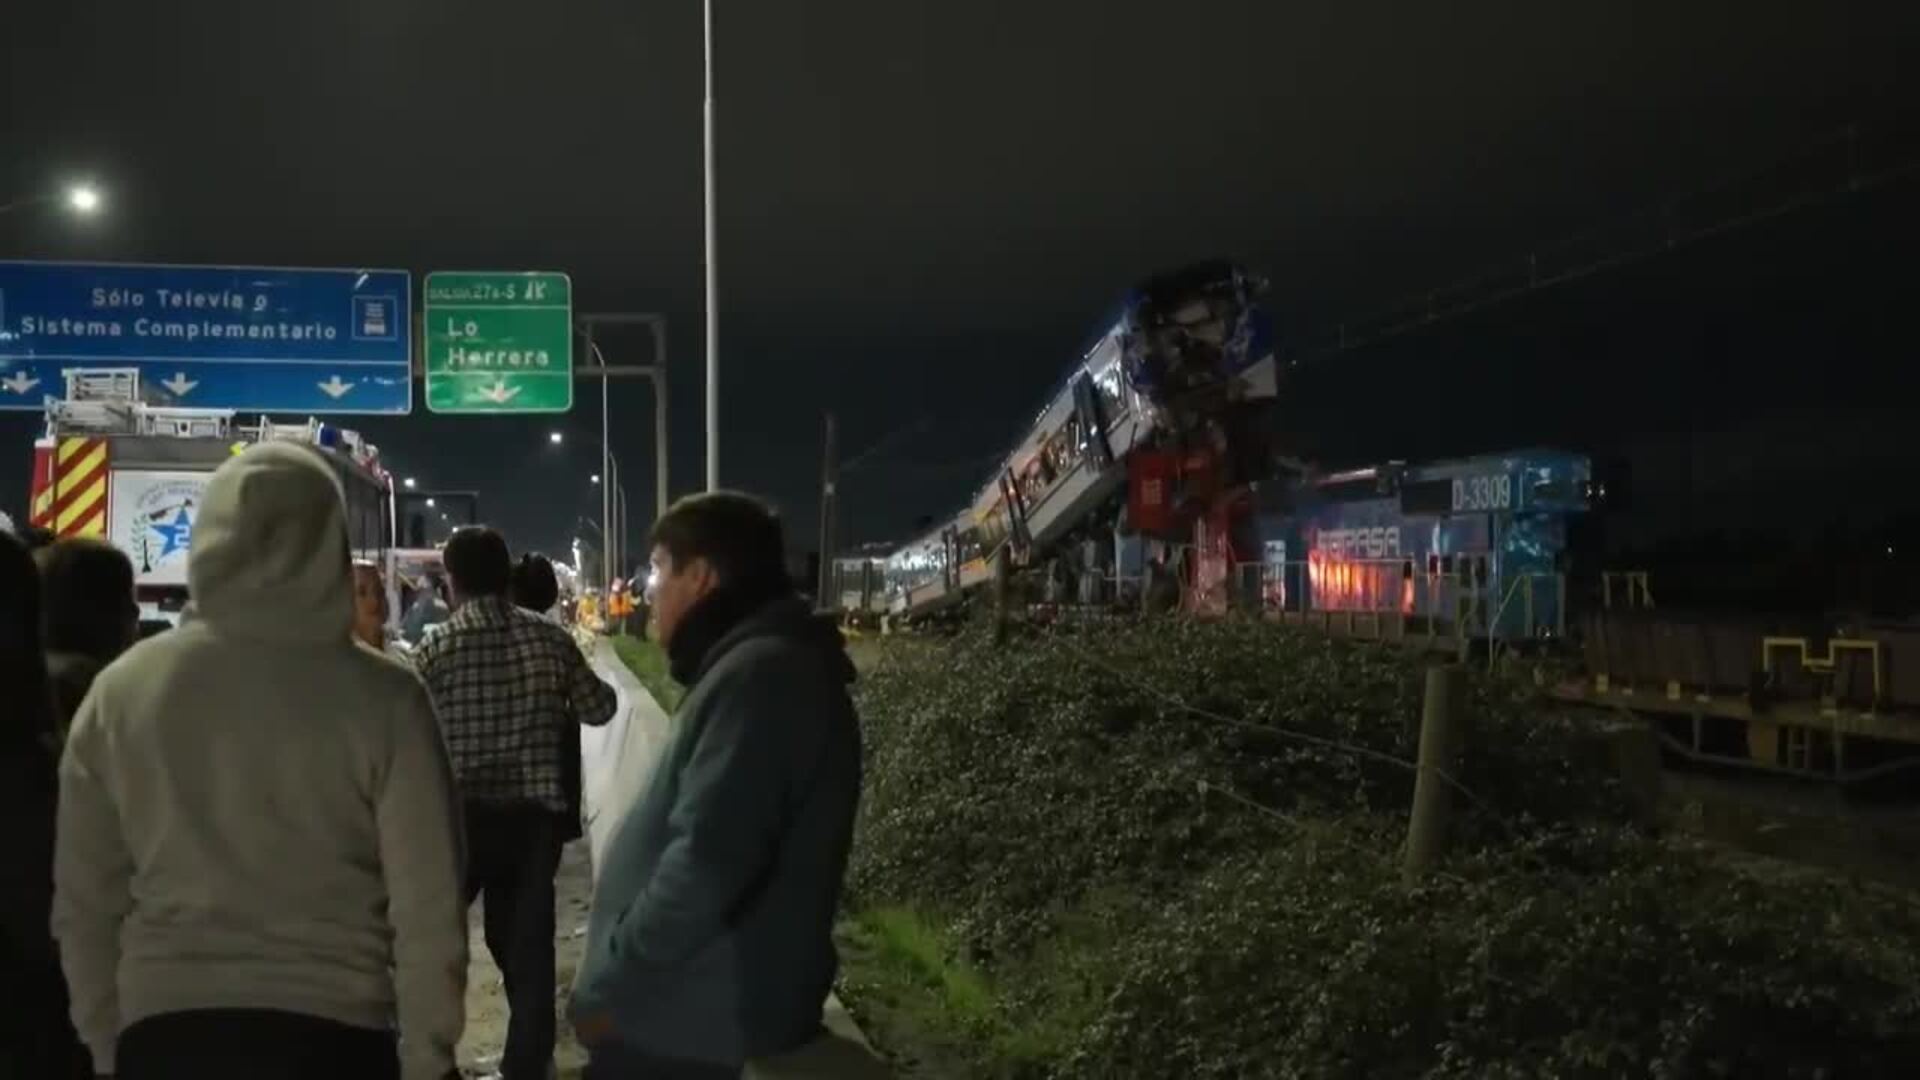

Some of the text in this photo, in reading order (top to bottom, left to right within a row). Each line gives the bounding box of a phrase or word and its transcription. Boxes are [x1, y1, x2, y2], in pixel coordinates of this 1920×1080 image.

[92, 288, 144, 307] Sólo
[156, 289, 243, 309] Televía
[21, 316, 337, 341] Sistema Complementario
[447, 317, 478, 337] Lo
[448, 347, 549, 367] Herrera
[1452, 475, 1511, 511] D-3309
